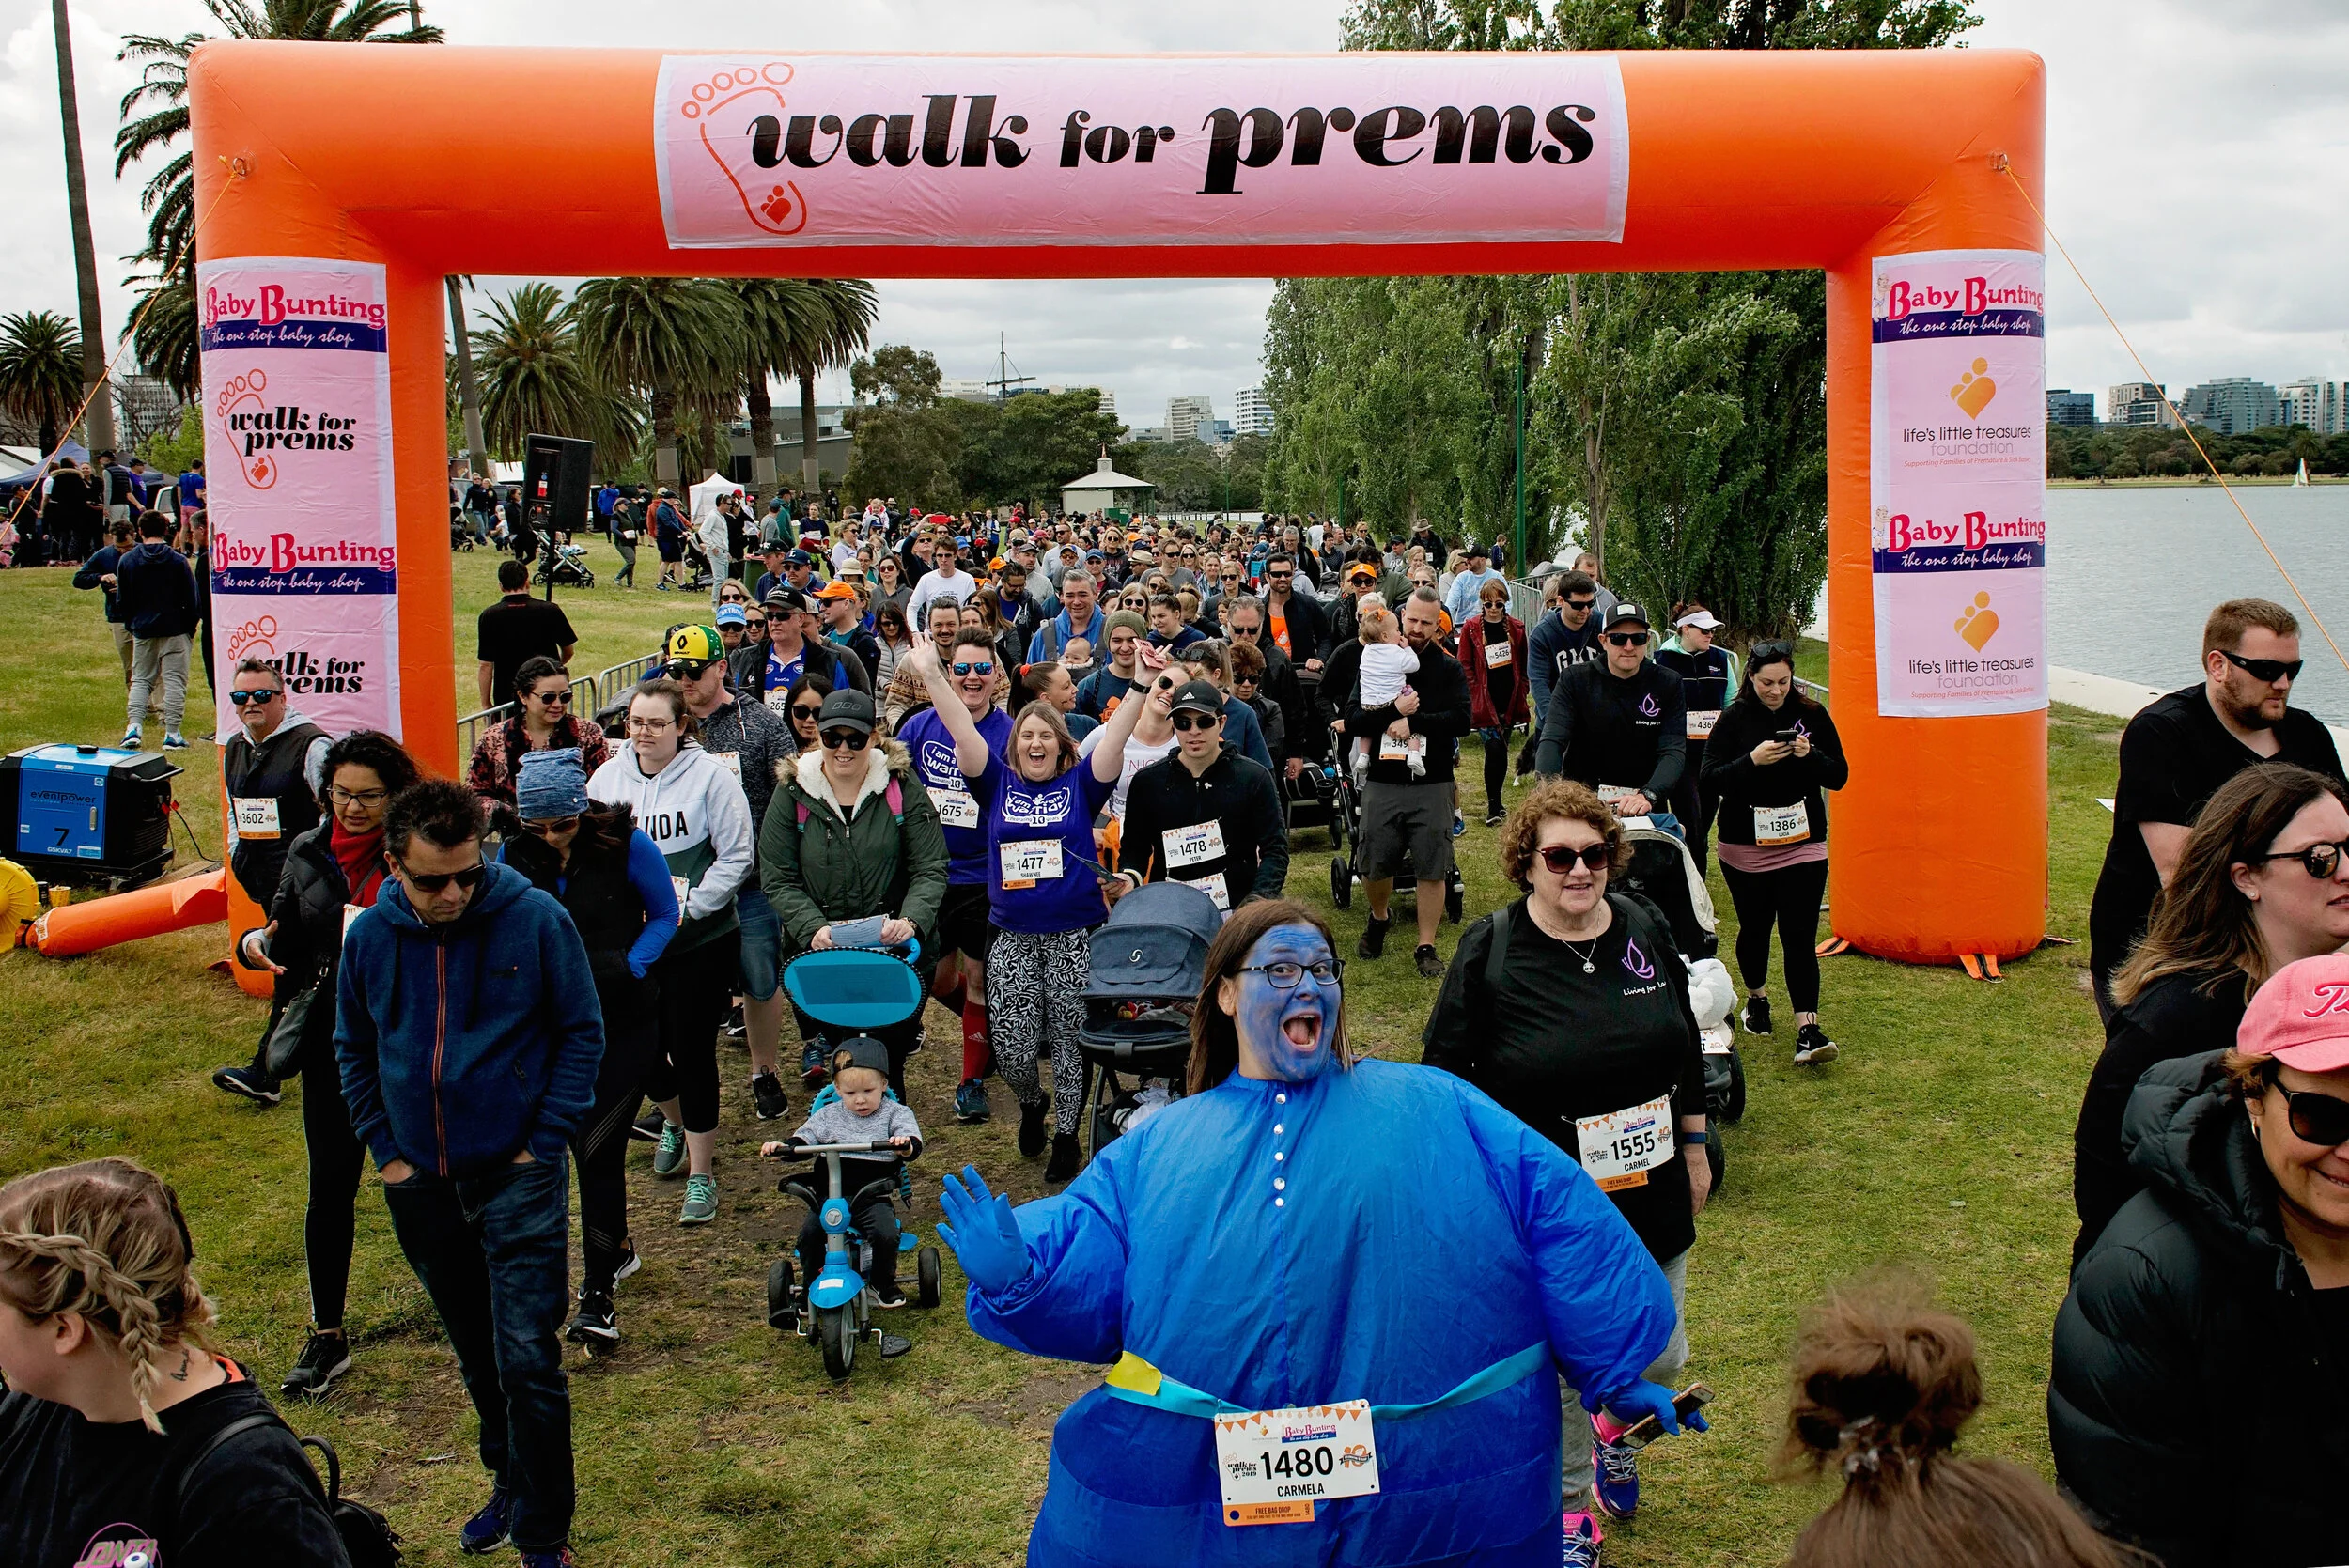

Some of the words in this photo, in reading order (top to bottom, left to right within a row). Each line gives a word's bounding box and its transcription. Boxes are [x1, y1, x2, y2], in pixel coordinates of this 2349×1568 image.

[746, 94, 1031, 168] walk
[1060, 110, 1174, 168] for
[1195, 104, 1595, 194] prems
[205, 287, 256, 329] Baby
[258, 284, 386, 330] Bunting
[1886, 280, 1959, 322] Baby
[1962, 276, 2044, 317] Bunting
[1899, 318, 1921, 334] the
[1922, 321, 1947, 332] one
[1950, 316, 1979, 335] stop
[1980, 314, 2009, 334] baby
[2010, 314, 2031, 334] shop
[212, 328, 225, 344] the
[226, 331, 246, 341] one
[247, 328, 276, 346] stop
[278, 325, 315, 348] baby
[318, 327, 355, 348] shop
[230, 406, 311, 431] walk
[318, 412, 357, 431] for
[1903, 427, 1936, 442] life's
[1939, 426, 1973, 441] little
[1975, 425, 2031, 440] treasures
[244, 432, 355, 458] prems
[1931, 441, 2014, 457] foundation
[1904, 458, 1939, 468] Supporting
[1887, 513, 1959, 552] Baby
[1963, 510, 2046, 551] Bunting
[214, 532, 266, 573] Baby
[269, 532, 396, 573] Bunting
[1901, 552, 1921, 567] the
[1923, 555, 1948, 566] one
[1951, 552, 1980, 569] stop
[1981, 548, 2010, 567] baby
[2011, 547, 2033, 567] shop
[223, 573, 236, 588] the
[236, 579, 256, 588] one
[257, 575, 287, 593] stop
[288, 572, 325, 594] baby
[328, 572, 365, 593] shop
[241, 651, 319, 675] alk
[326, 657, 365, 675] for
[1494, 650, 1510, 660] 5426
[1909, 660, 1941, 675] life's
[1945, 659, 1978, 674] little
[1981, 657, 2034, 672] treasures
[1937, 673, 2018, 689] foundation
[1911, 691, 1946, 699] Supporting
[1697, 720, 1715, 729] 436
[1392, 738, 1408, 749] 349
[935, 751, 951, 762] am
[927, 759, 961, 777] warr
[950, 779, 960, 788] 10
[30, 790, 97, 803] eventpower
[241, 813, 264, 824] 3602
[938, 804, 962, 817] 1675
[634, 811, 689, 842] NDA
[1033, 816, 1046, 825] 10
[1770, 818, 1796, 831] 1386
[54, 827, 70, 846] 7
[1179, 840, 1207, 856] 1478
[1017, 857, 1043, 871] 1477
[1623, 986, 1646, 996] Living
[1646, 985, 1656, 993] for
[1610, 1130, 1656, 1161] 1555
[1624, 1157, 1650, 1172] CARMEL
[1284, 1426, 1305, 1438] Baby
[1304, 1424, 1336, 1436] Bunting
[1260, 1446, 1333, 1480] 1480
[1277, 1483, 1325, 1498] CARMELA
